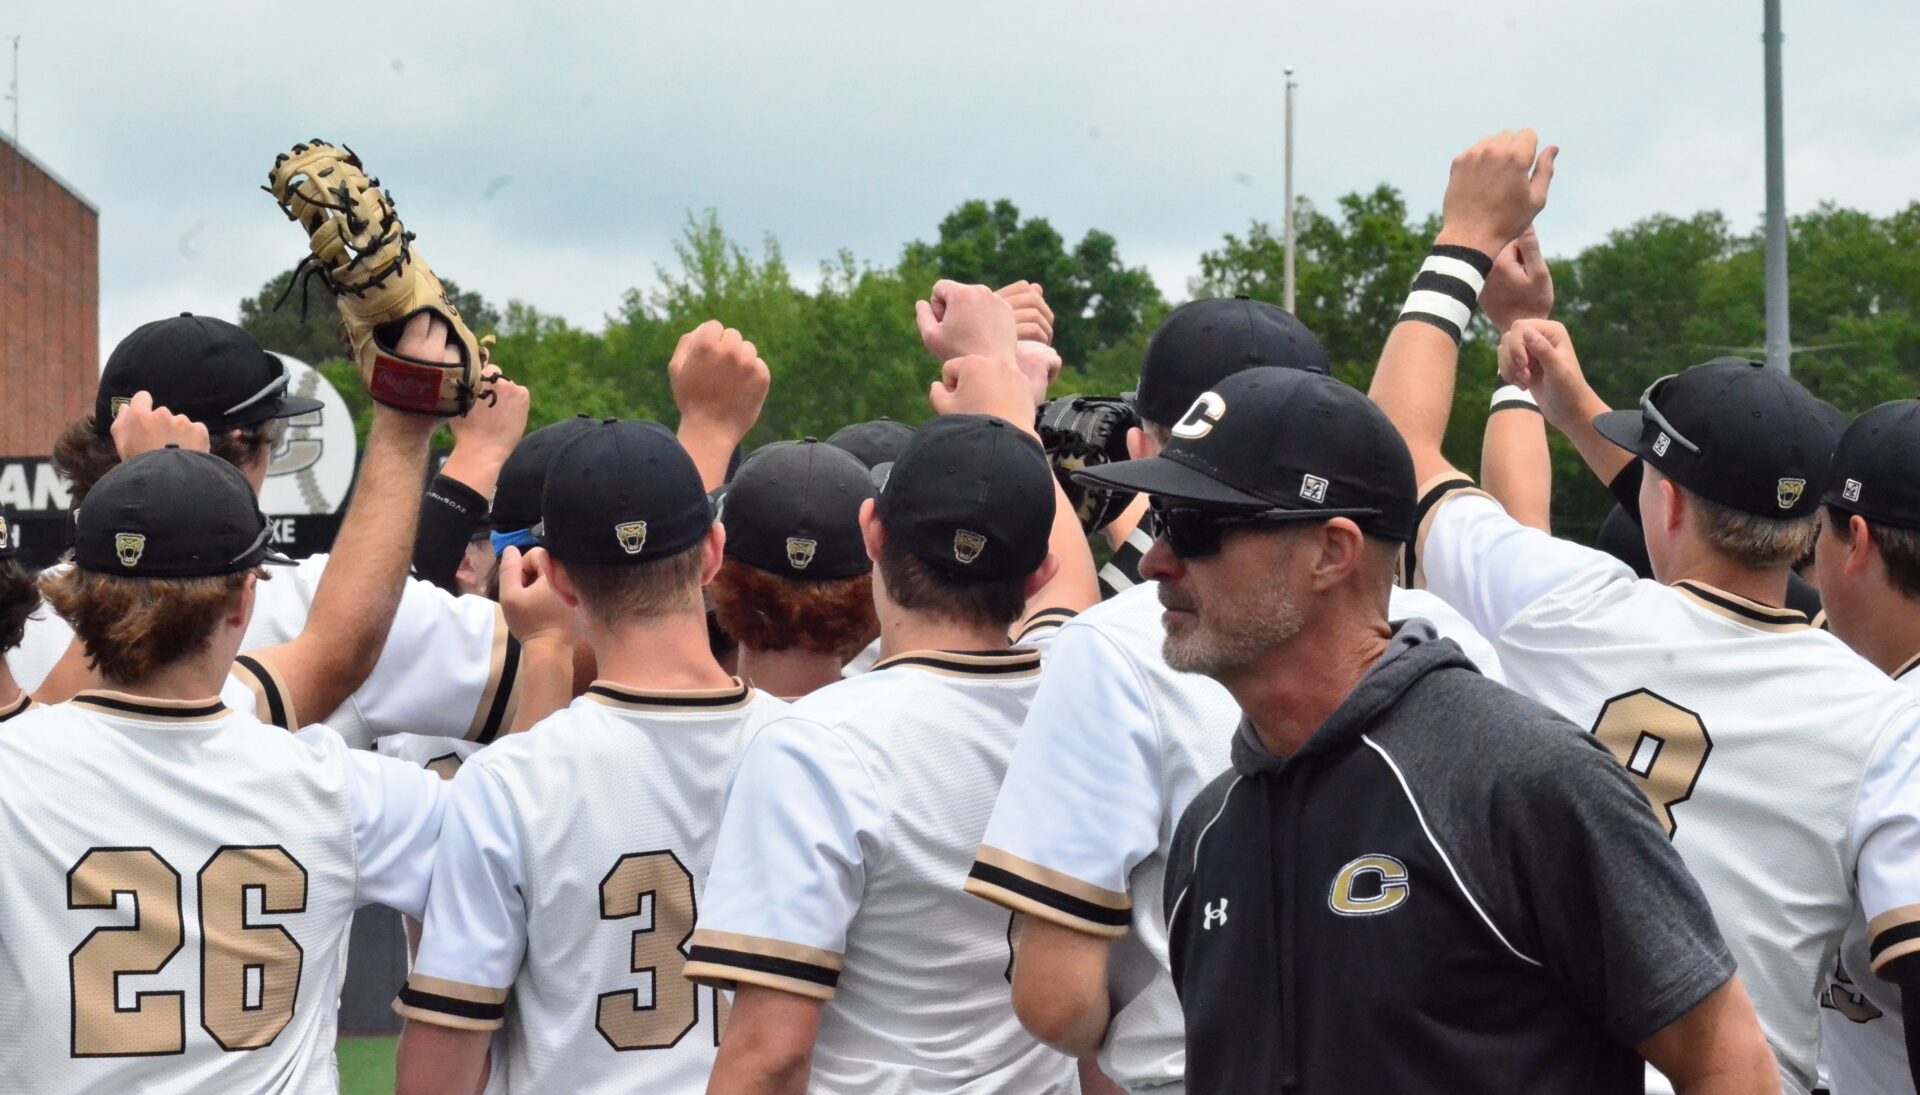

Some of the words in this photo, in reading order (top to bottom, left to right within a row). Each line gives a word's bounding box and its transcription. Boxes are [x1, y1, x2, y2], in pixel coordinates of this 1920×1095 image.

[1171, 391, 1226, 439] C
[66, 844, 309, 1058] 26
[595, 849, 734, 1052] 3
[1328, 853, 1410, 916] C
